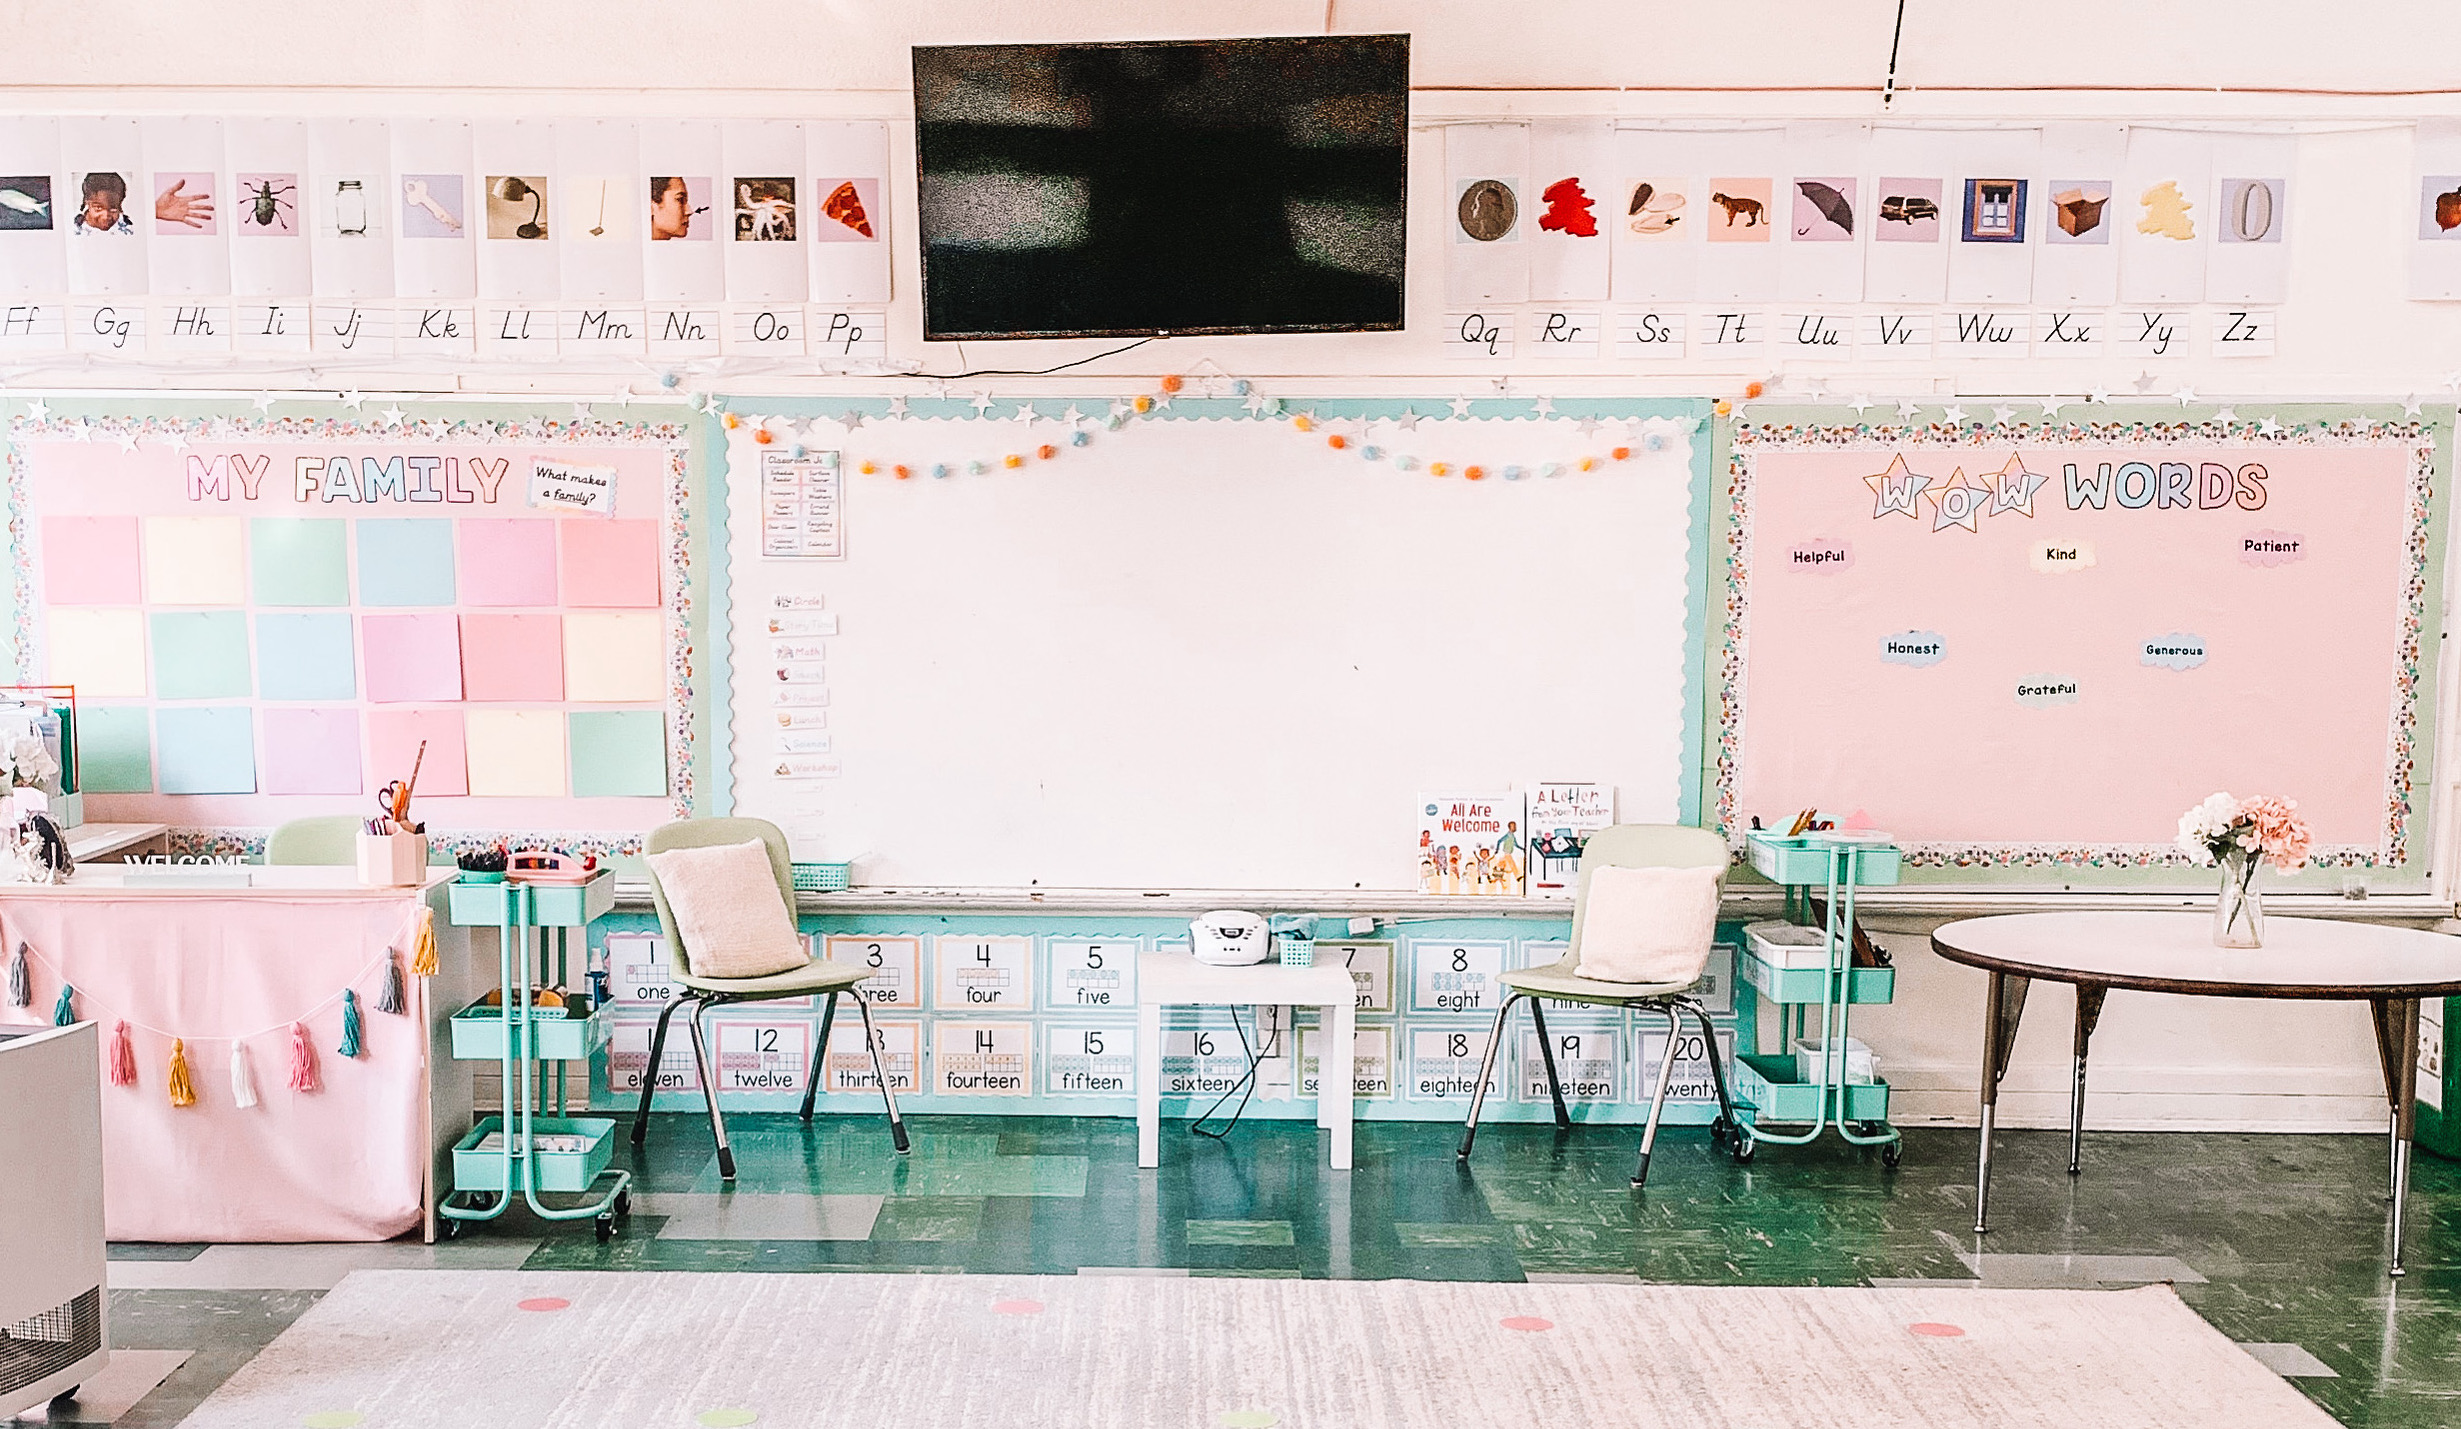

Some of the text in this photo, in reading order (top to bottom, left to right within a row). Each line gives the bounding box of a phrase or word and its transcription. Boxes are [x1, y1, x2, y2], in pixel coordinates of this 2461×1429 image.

[6, 307, 39, 334] Ff
[94, 308, 130, 348] Gg
[174, 307, 214, 335] Hh
[262, 307, 284, 334] Ii
[334, 308, 361, 349] Jj
[419, 310, 459, 337] Kk
[501, 311, 529, 339] Ll
[578, 311, 632, 339] Mm
[664, 312, 705, 340] Nn
[754, 313, 788, 341] Oo
[1543, 314, 1581, 342] Rr
[1637, 314, 1670, 342] Ss
[1717, 314, 1745, 343] Tt
[1799, 316, 1838, 345] Uu
[1881, 316, 1912, 344] Vv
[1959, 314, 2013, 342] Ww
[2045, 314, 2089, 342] Xx
[2222, 313, 2257, 341] Zz
[828, 314, 862, 354] Pp
[1462, 314, 1499, 355] Qq
[2139, 313, 2172, 354] Yy
[187, 455, 509, 503] MY FAMILY
[536, 466, 567, 481] What
[543, 488, 596, 505] a family?
[1881, 462, 2268, 519] WOW WORDS
[1794, 551, 1844, 564] Helpful
[2047, 549, 2076, 560] Kind
[2245, 540, 2299, 552] Patient
[796, 648, 820, 656] Math
[1888, 642, 1939, 655] Honest
[2147, 645, 2202, 655] Generous
[2018, 684, 2075, 696] Grateful
[1538, 787, 1599, 805] A Letter
[1451, 803, 1464, 817] All
[1469, 804, 1491, 817] Are
[1442, 819, 1500, 833] Welcome
[867, 944, 882, 967] 3
[976, 944, 992, 968] 4
[1087, 946, 1103, 970] 5
[1341, 948, 1356, 968] 7
[1452, 949, 1468, 971] 8
[638, 988, 669, 999] one
[967, 986, 1001, 1002] four
[1078, 987, 1110, 1005] five
[1437, 990, 1480, 1012] eight
[756, 1029, 777, 1052] 12
[975, 1029, 994, 1054] 14
[1085, 1032, 1103, 1054] 15
[1194, 1032, 1214, 1056] 16
[1449, 1034, 1468, 1057] 18
[1561, 1037, 1580, 1059] 19
[1674, 1038, 1704, 1061] 20
[735, 1070, 792, 1087] twelve
[947, 1072, 1020, 1088] fourteen
[1062, 1071, 1123, 1090] fifteen
[1172, 1075, 1235, 1092] sixteen
[1532, 1080, 1610, 1096] nieteen
[1663, 1081, 1718, 1101] wenty
